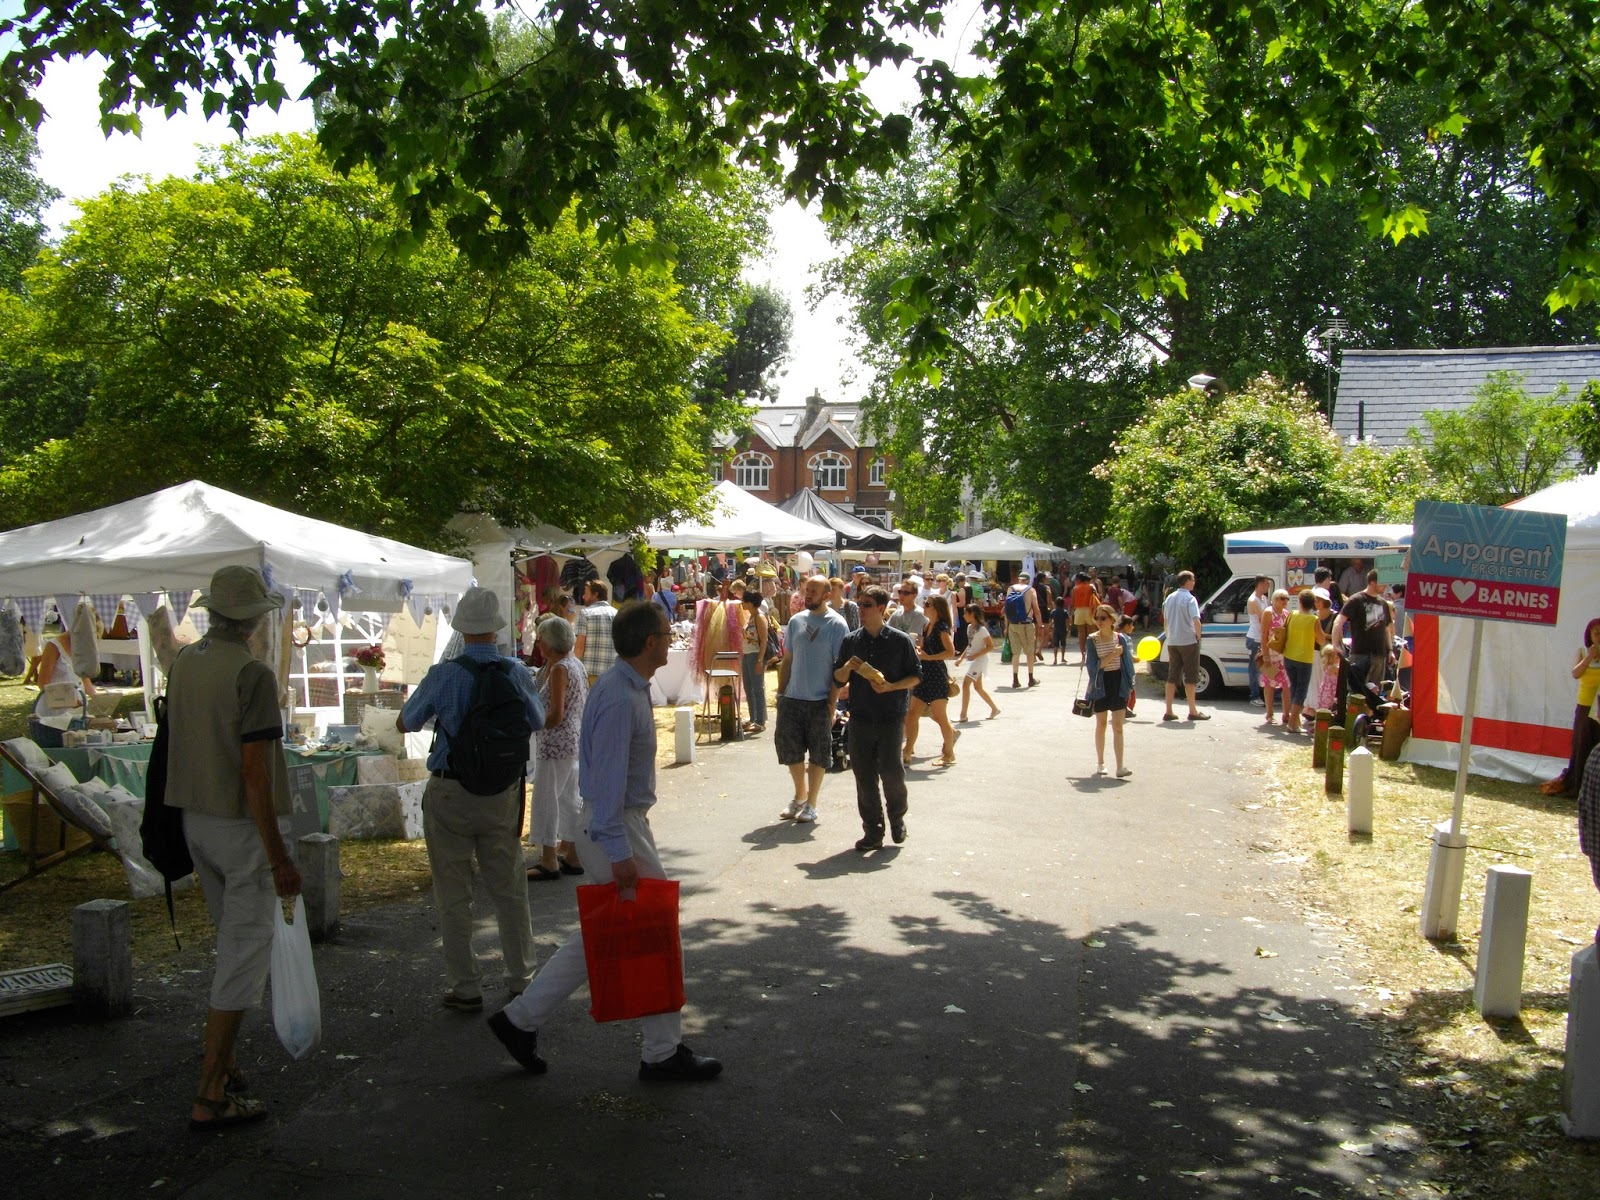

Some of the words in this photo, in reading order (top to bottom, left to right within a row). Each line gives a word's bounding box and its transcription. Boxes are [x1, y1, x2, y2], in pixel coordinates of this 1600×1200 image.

[1422, 535, 1553, 568] Apparent
[1470, 562, 1549, 581] PROPERTIES
[1418, 581, 1448, 599] WE
[1478, 588, 1550, 609] BARNES
[1422, 603, 1501, 616] www.apparentproperties.com
